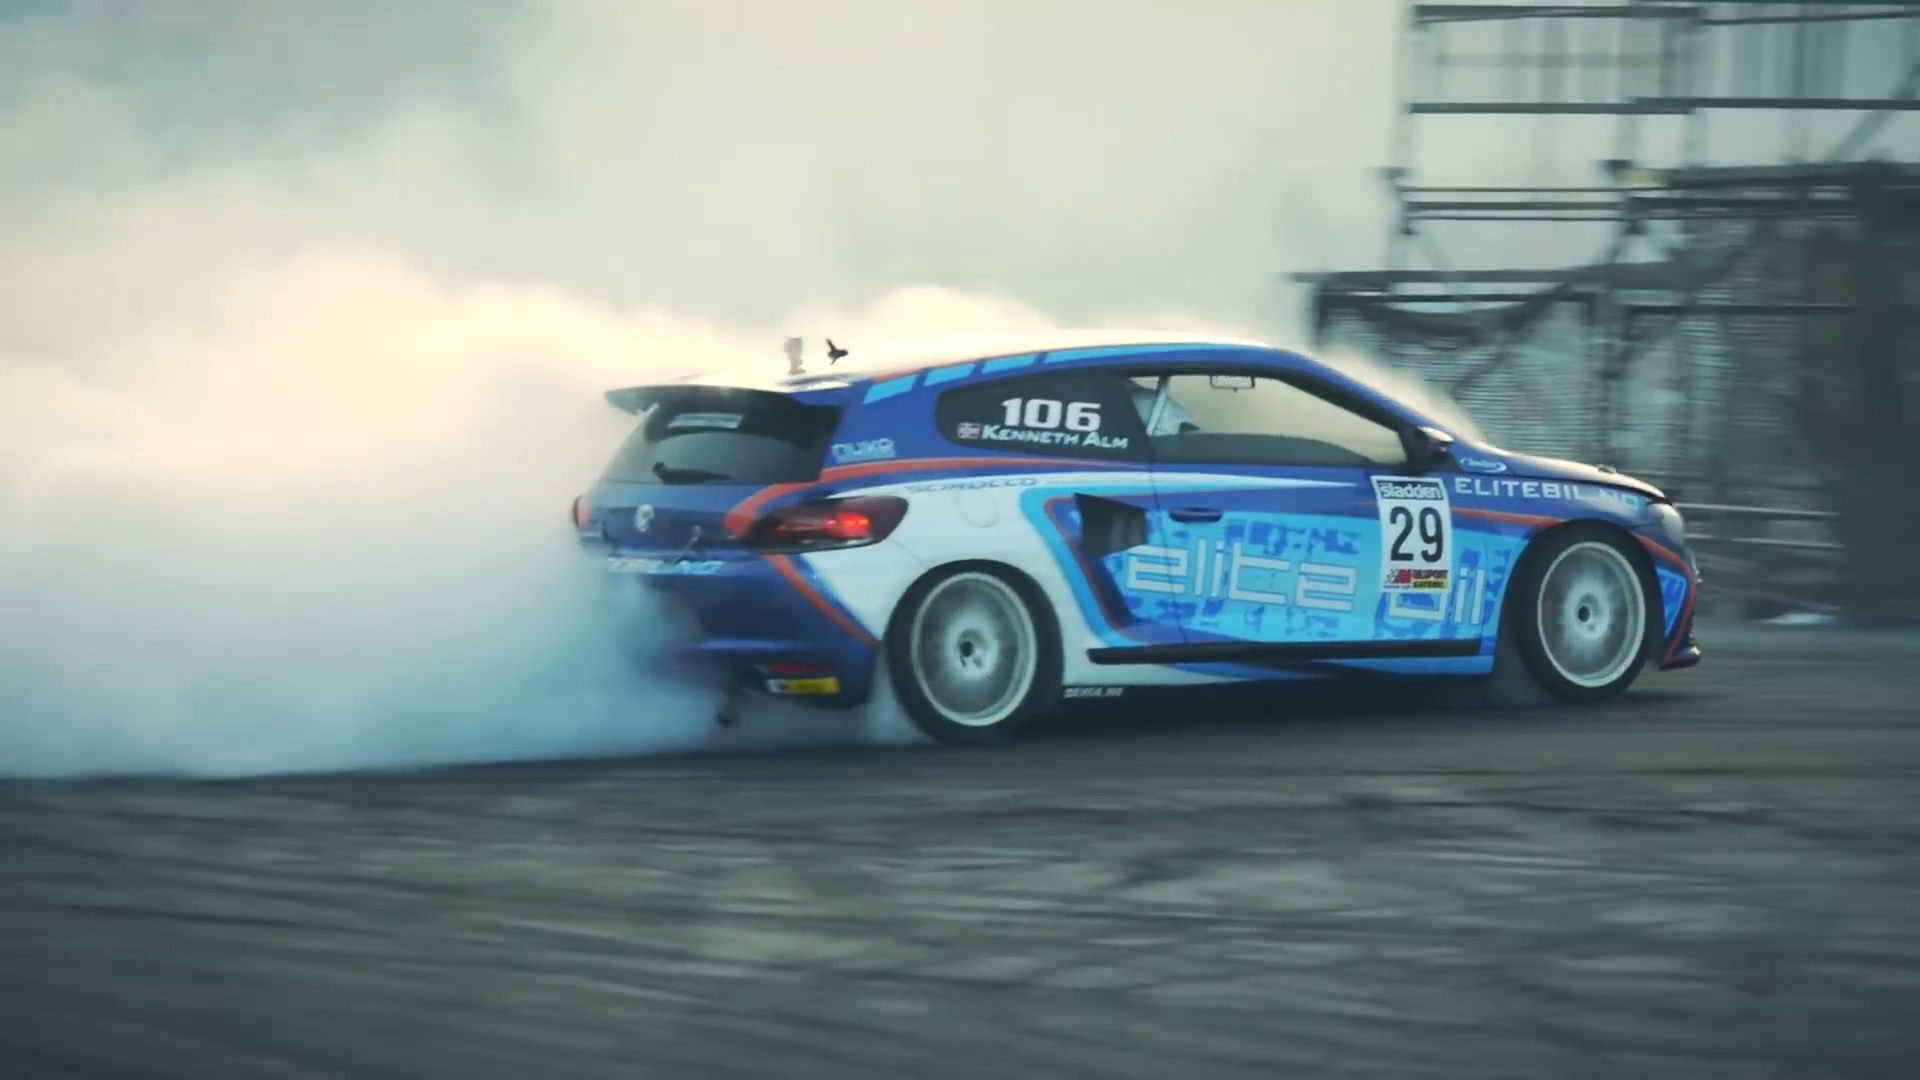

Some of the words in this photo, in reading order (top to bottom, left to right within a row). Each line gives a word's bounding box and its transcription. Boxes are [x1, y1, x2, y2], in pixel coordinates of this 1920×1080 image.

[1002, 398, 1101, 432] 106
[1390, 506, 1443, 563] 29
[1126, 538, 1357, 612] elite
